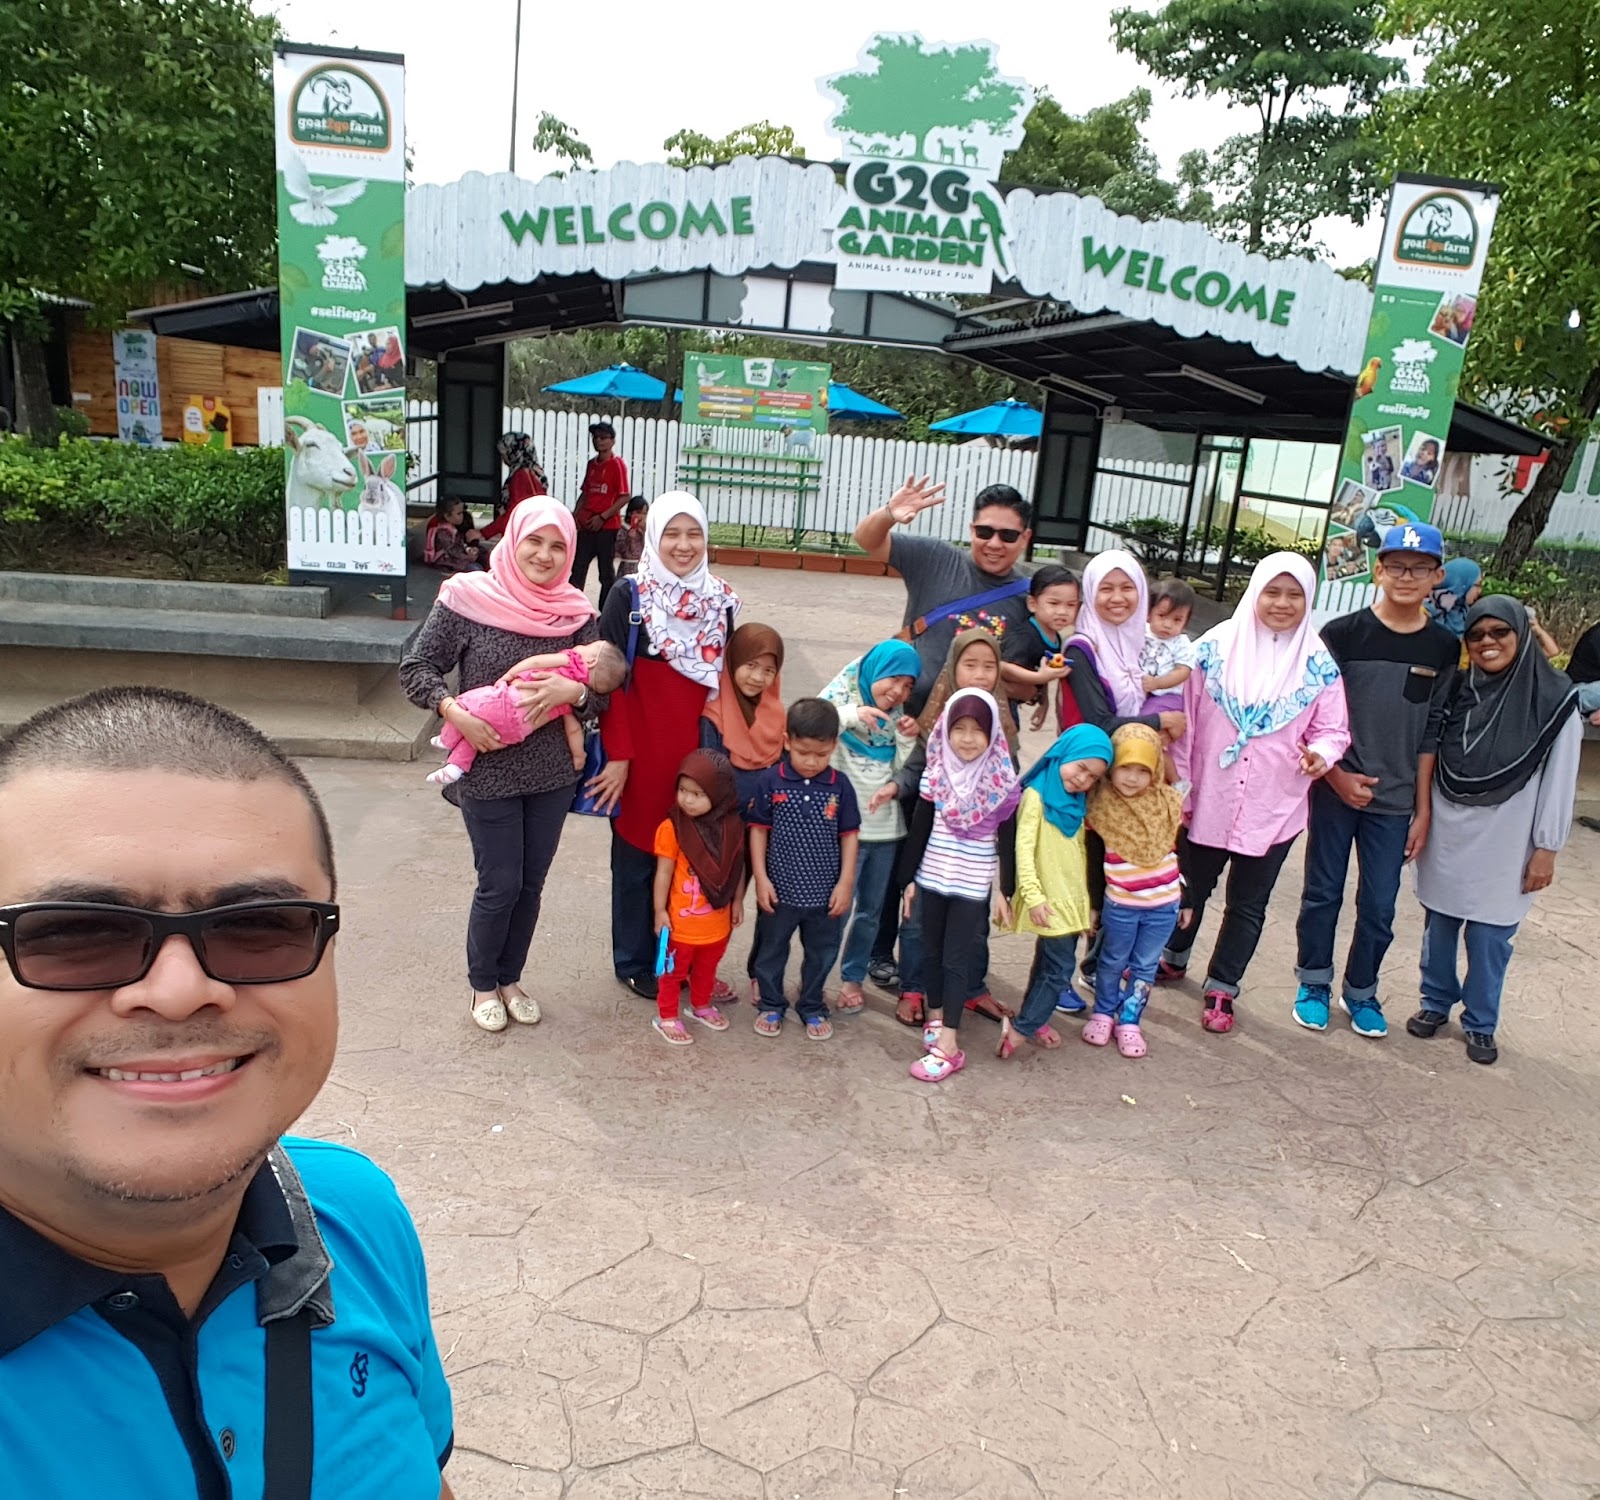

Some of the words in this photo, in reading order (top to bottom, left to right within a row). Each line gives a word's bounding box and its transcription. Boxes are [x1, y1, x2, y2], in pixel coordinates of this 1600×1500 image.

[853, 161, 971, 214] G2G
[500, 195, 755, 247] WELCOME
[837, 206, 988, 243] ANIMAL
[838, 231, 985, 267] GARDEN
[847, 261, 892, 273] ANIMALS
[904, 267, 942, 278] NATURE
[954, 272, 975, 280] FUN
[1082, 236, 1296, 327] WELCOME
[310, 305, 377, 323] #selfieg2g
[119, 379, 157, 398] NOW
[119, 398, 158, 416] OPEN
[1402, 526, 1422, 548] LA
